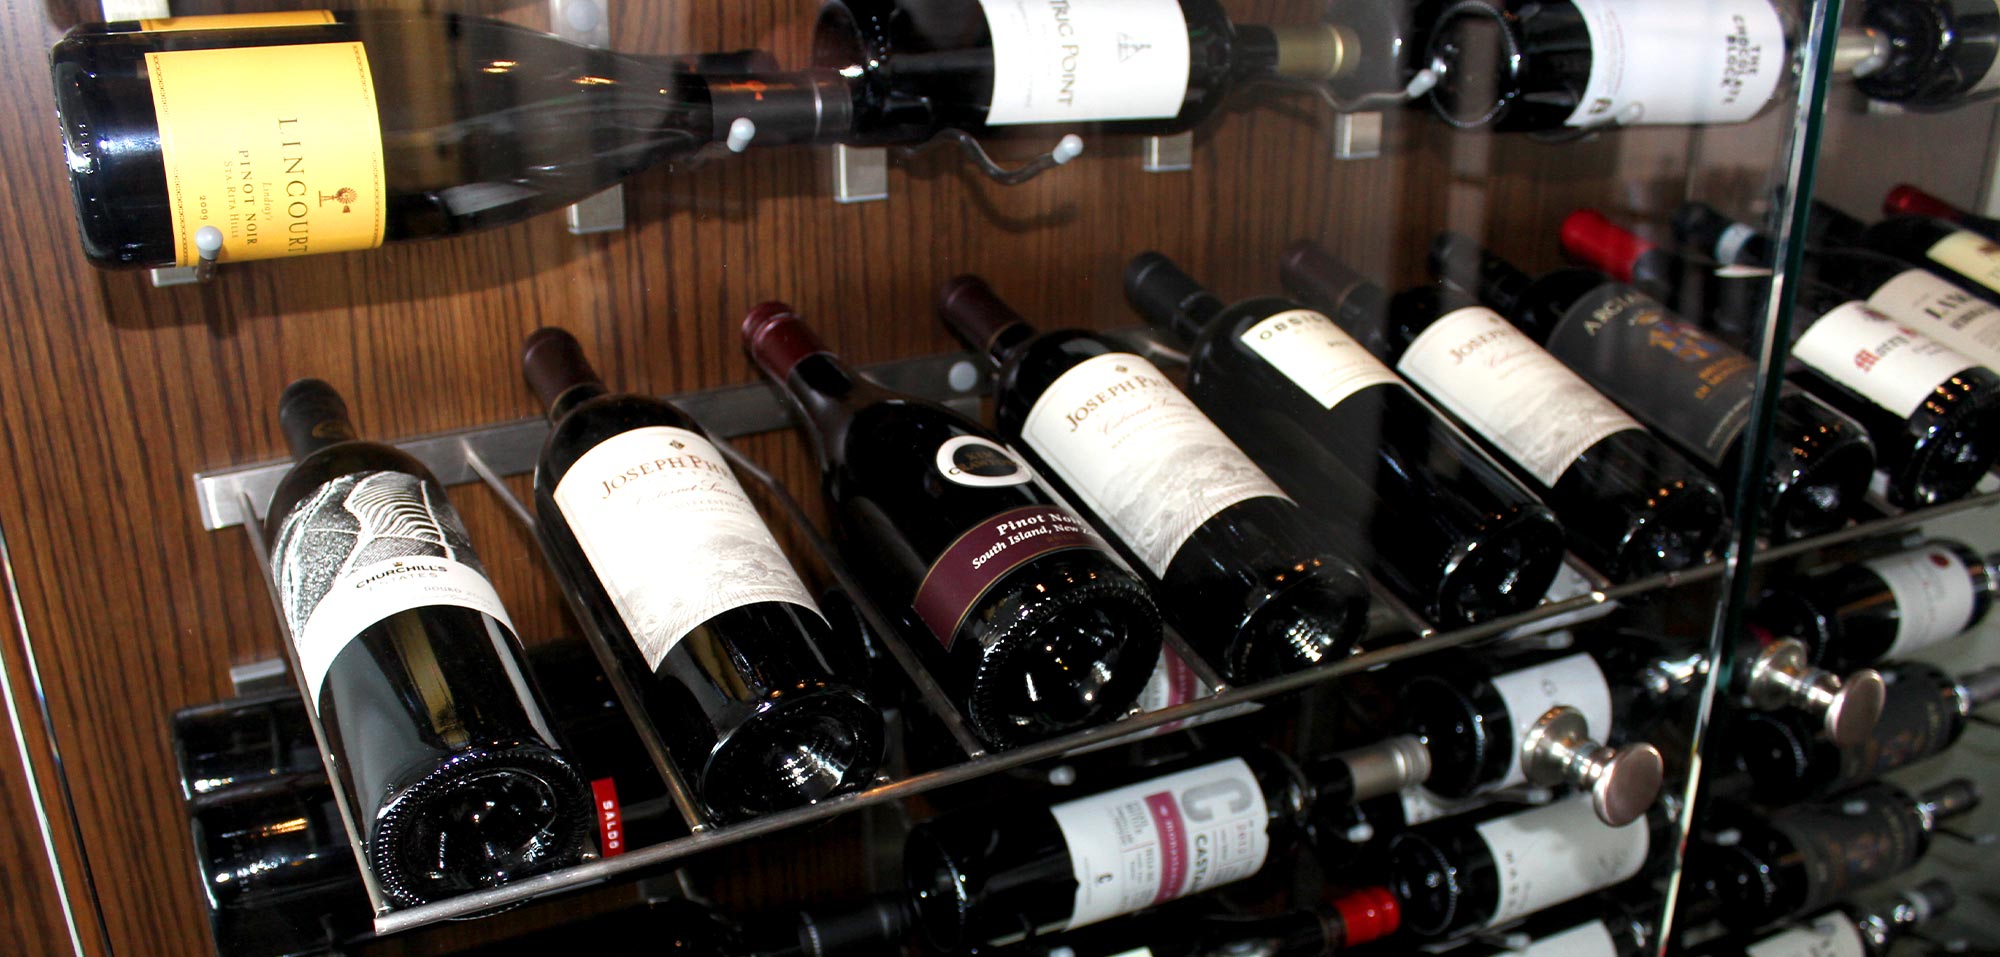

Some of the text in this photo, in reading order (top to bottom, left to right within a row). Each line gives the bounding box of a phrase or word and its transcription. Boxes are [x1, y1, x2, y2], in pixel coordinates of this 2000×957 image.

[1057, 44, 1079, 107] POINT
[199, 195, 209, 221] 2009
[226, 185, 237, 212] RITA
[238, 150, 258, 246] PINOT NOIR
[278, 117, 309, 253] LINCOURT
[1064, 377, 1135, 433] JOSEPH
[601, 456, 685, 499] JOSEPH
[971, 541, 1007, 570] South
[1008, 525, 1052, 546] Island,
[1053, 523, 1079, 534] New
[996, 513, 1045, 537] Pinot
[602, 800, 619, 849] SALDO
